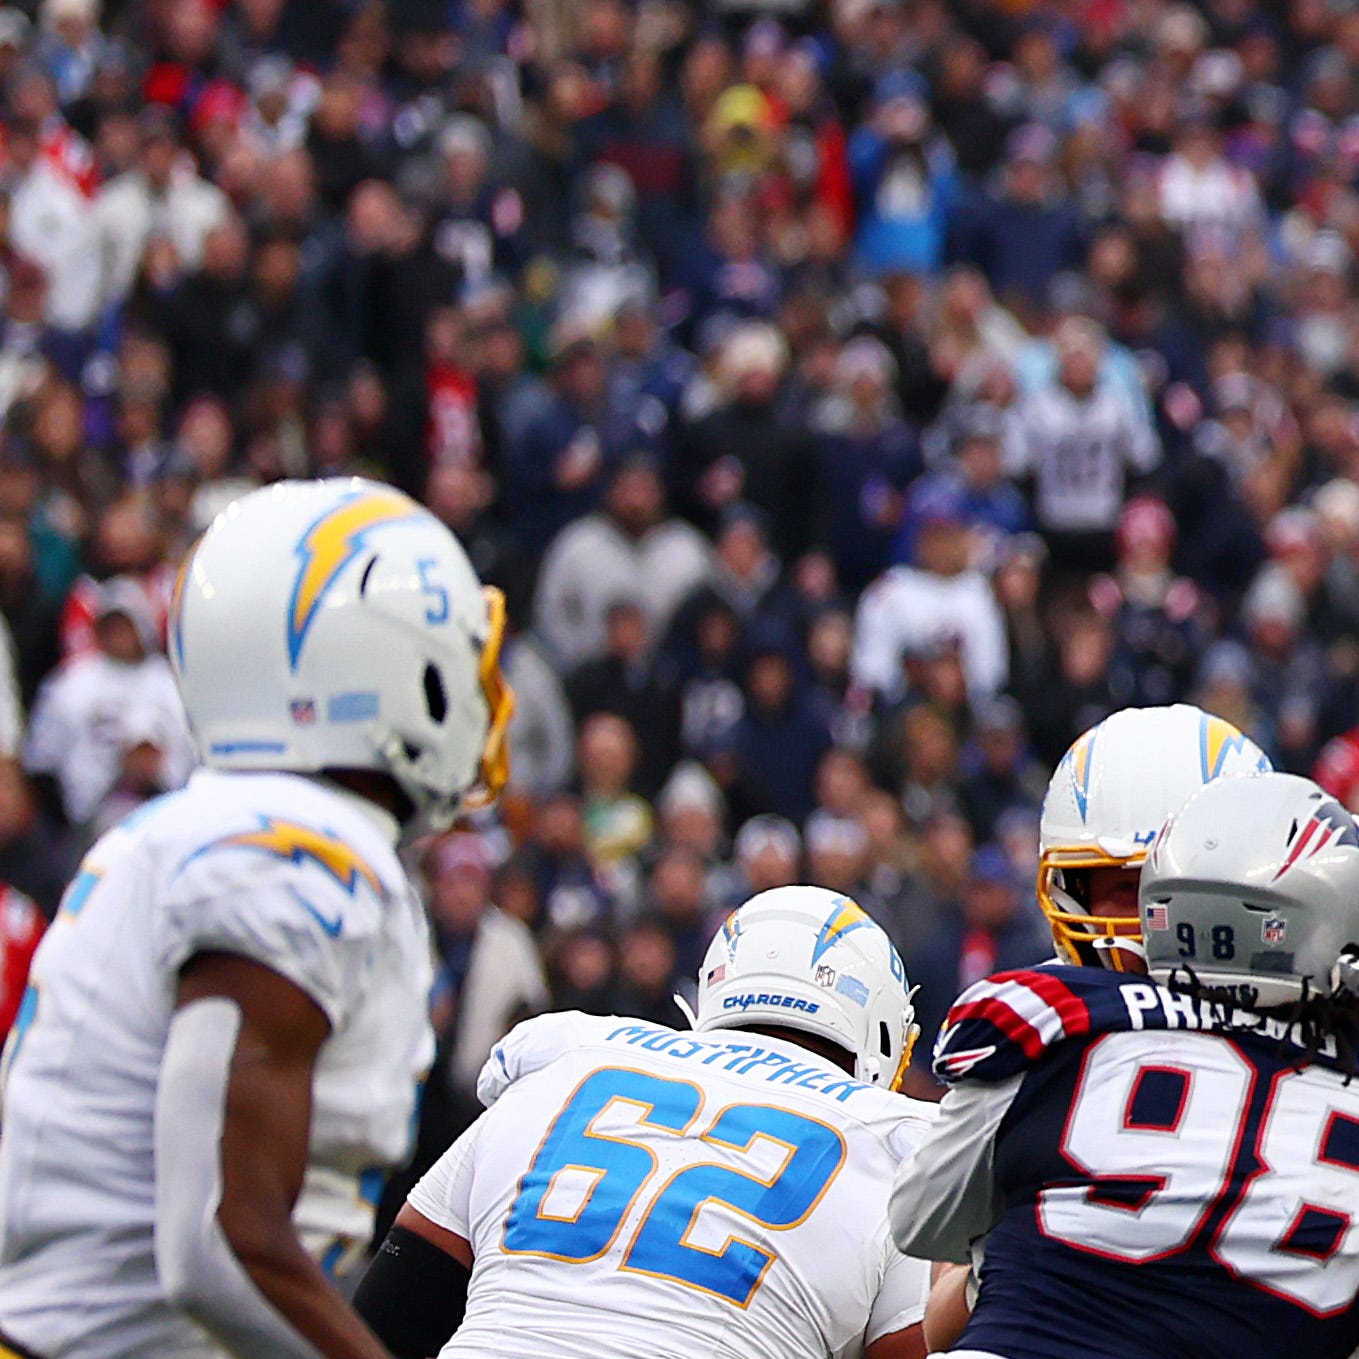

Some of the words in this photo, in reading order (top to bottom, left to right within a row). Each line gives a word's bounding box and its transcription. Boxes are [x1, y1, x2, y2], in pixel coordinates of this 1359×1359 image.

[417, 558, 449, 624] 5
[723, 993, 820, 1014] CHARGERS
[498, 1065, 848, 1310] 62
